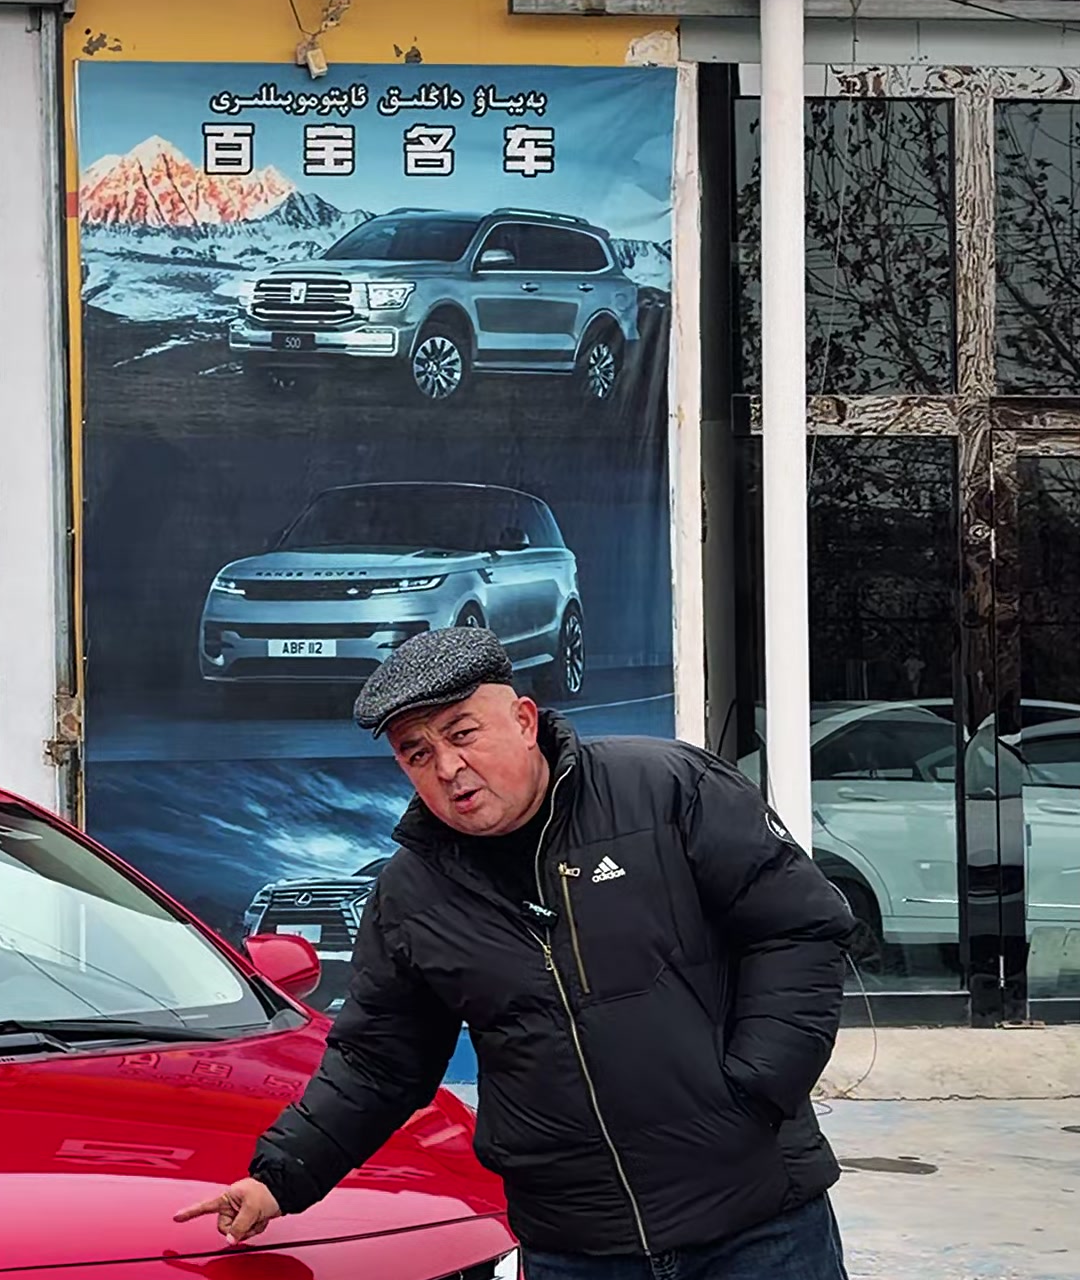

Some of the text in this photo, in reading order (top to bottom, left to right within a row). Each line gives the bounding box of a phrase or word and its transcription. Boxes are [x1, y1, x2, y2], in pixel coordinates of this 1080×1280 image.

[204, 124, 555, 176] 百宝名车
[284, 336, 302, 349] 500
[282, 642, 306, 655] ABF
